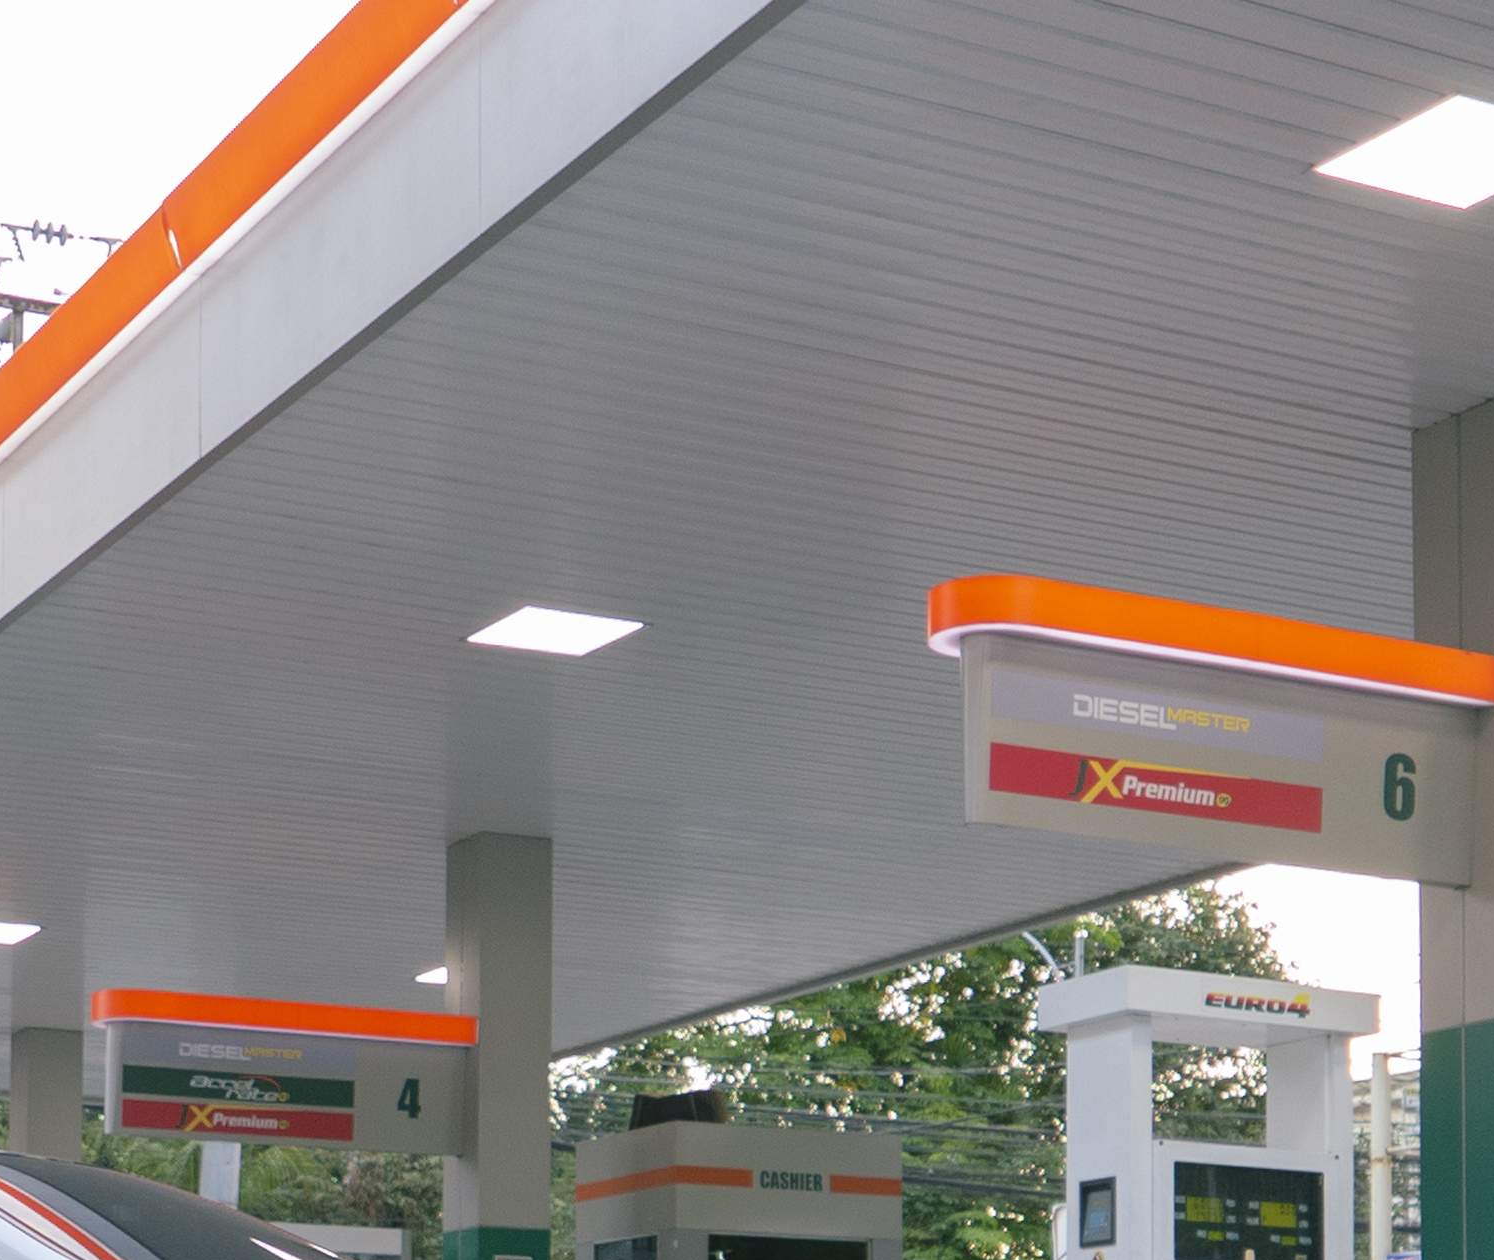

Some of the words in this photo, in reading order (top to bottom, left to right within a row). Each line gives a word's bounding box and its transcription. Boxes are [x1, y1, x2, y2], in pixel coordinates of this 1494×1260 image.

[1122, 775, 1215, 806] Premium
[1383, 753, 1416, 822] 6
[397, 1078, 421, 1118] 4
[213, 1112, 279, 1130] Premium
[759, 1170, 823, 1192] CASHIER
